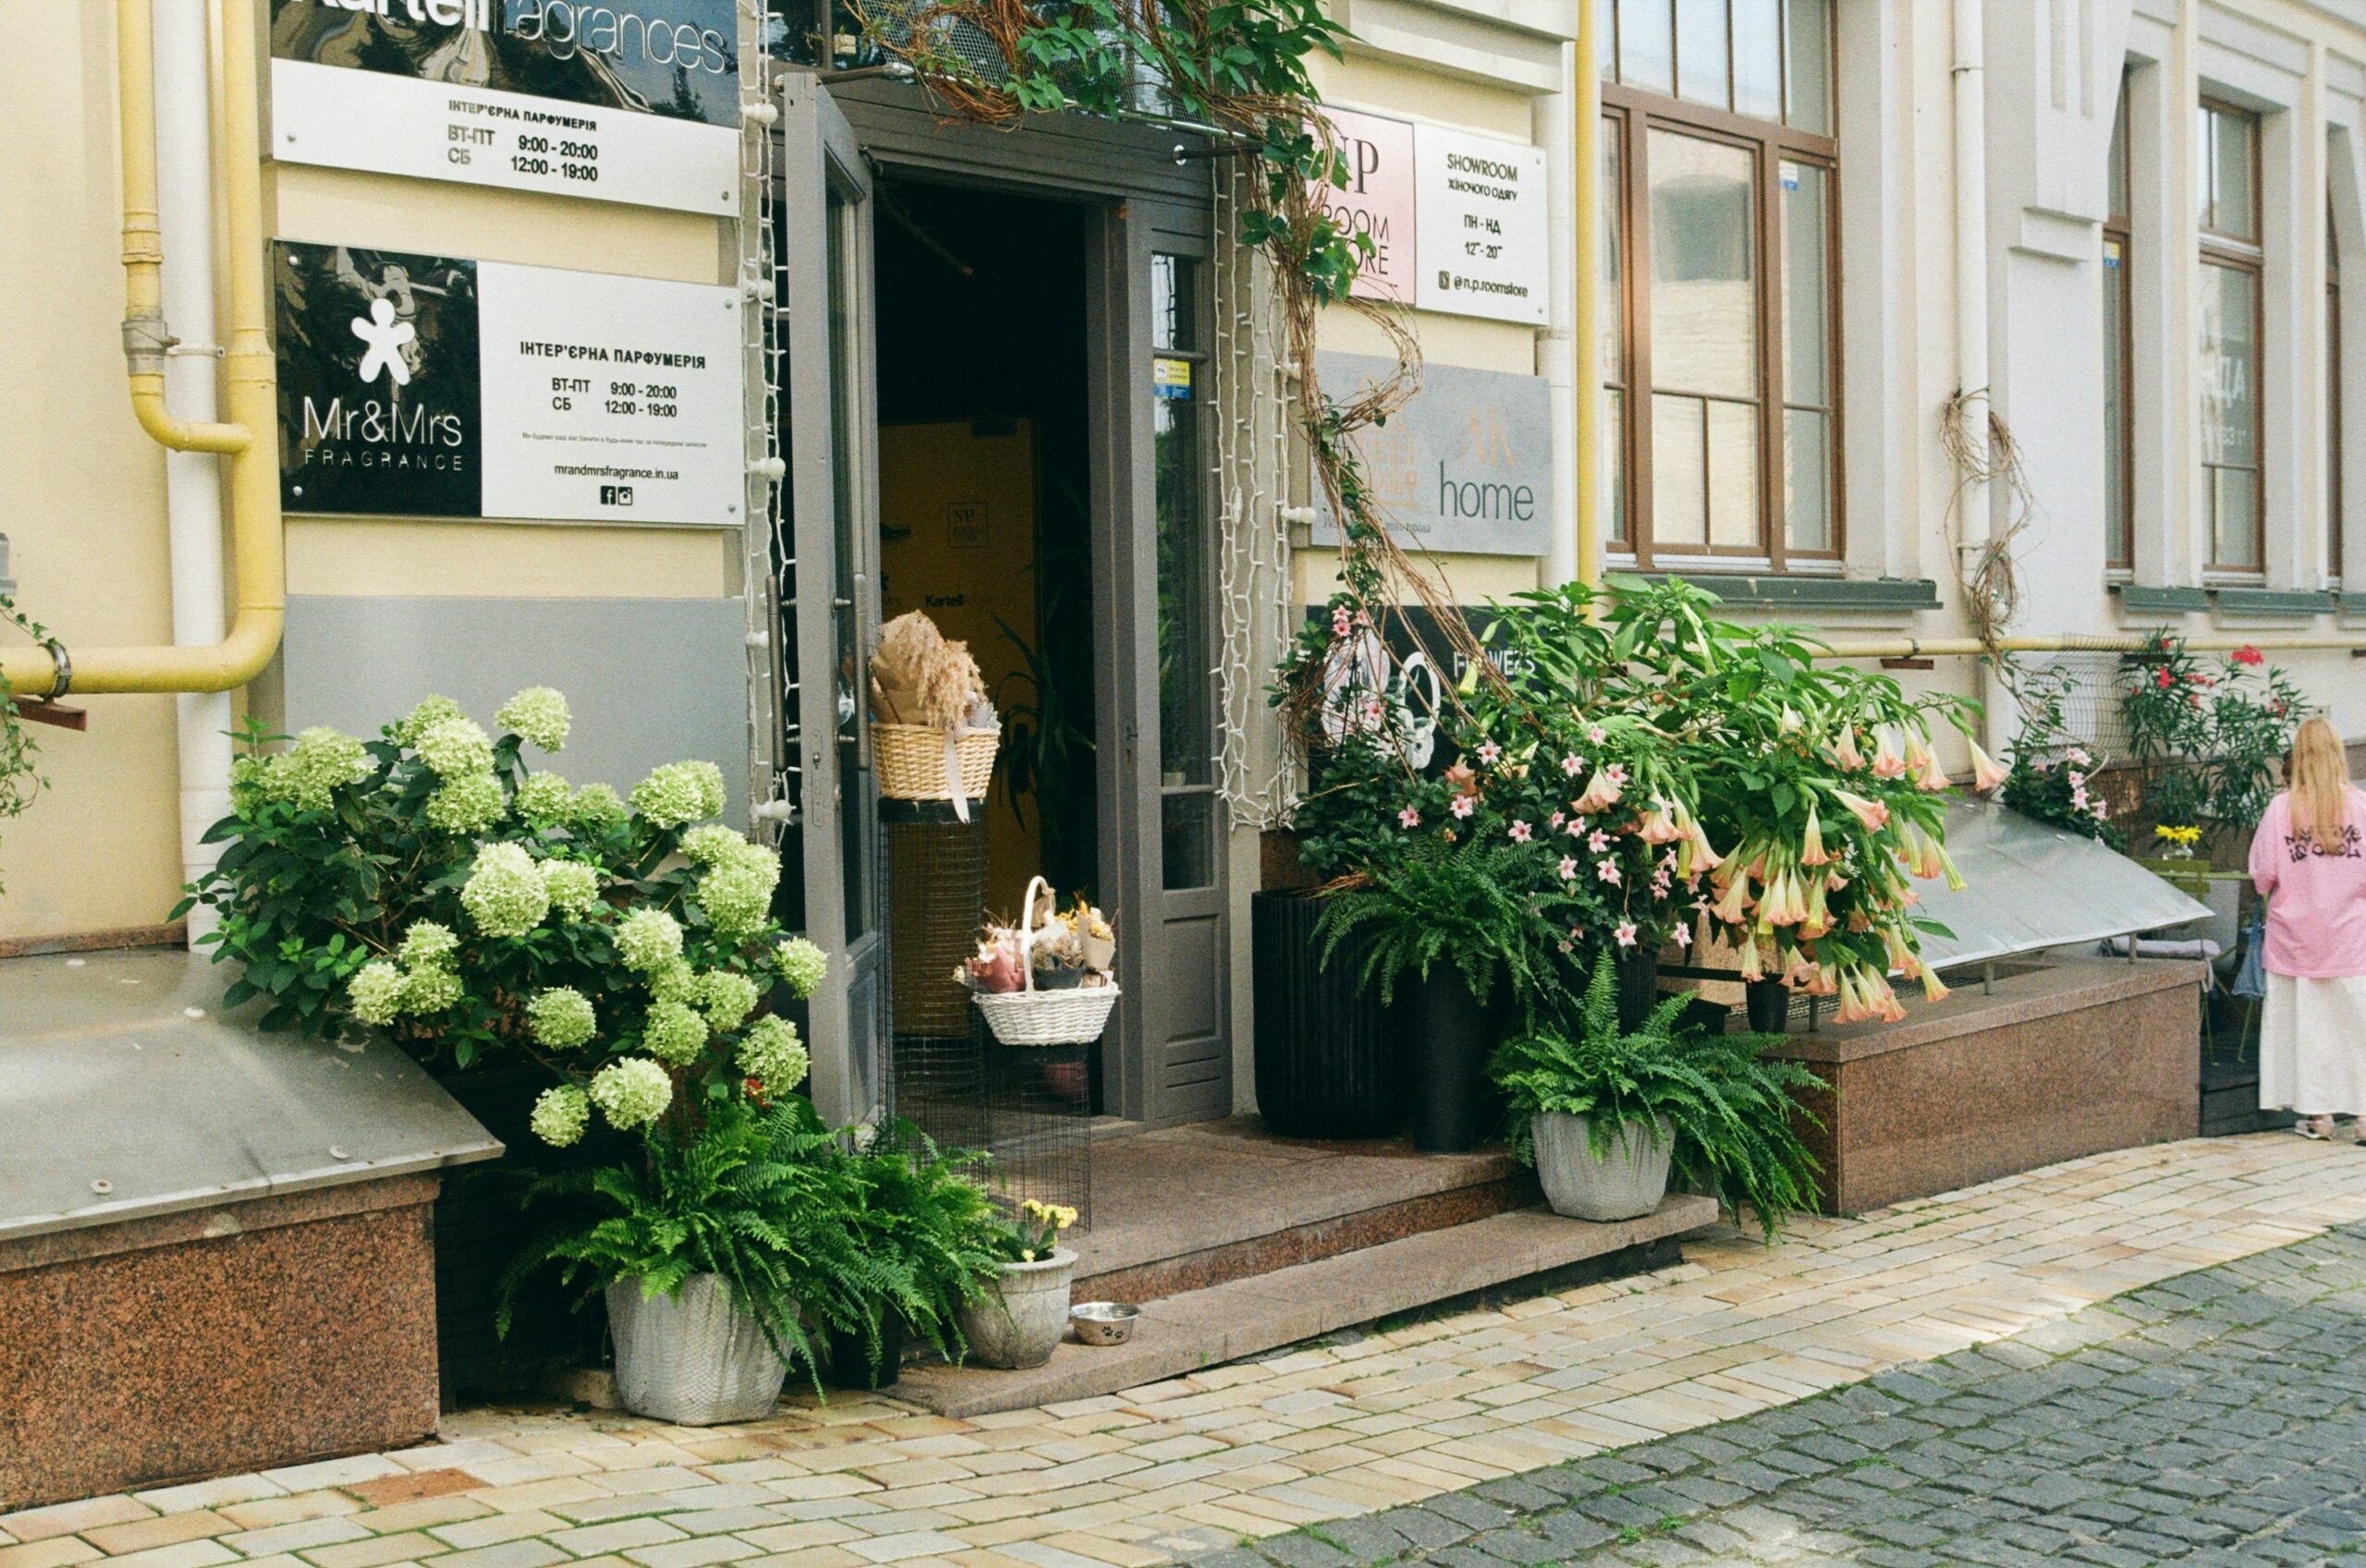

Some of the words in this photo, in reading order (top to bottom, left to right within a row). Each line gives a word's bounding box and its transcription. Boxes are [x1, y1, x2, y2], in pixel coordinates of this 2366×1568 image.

[448, 100, 519, 120] ІНТЕР'ЄРНА
[523, 111, 597, 131] ПАРФУМЕРІЯ
[447, 124, 495, 146] ВТ-ПТ
[518, 135, 549, 153] 9:00
[560, 140, 598, 160] 20:00
[447, 147, 471, 164] СБ
[511, 155, 549, 175] 12:00
[561, 163, 598, 181] 19:00
[1447, 152, 1518, 182] SHOWROOM
[1464, 213, 1478, 229] ПН
[1486, 217, 1501, 236] НД
[520, 340, 609, 361] ІНТЕР'ЄРНА
[614, 348, 706, 370] ПАРФУМЕРІЯ
[552, 377, 591, 393] ВТ-ПТ
[610, 382, 636, 396] 9:00
[645, 384, 677, 399] 20:00
[304, 395, 462, 447] Mr&Mrs
[552, 396, 572, 411] СБ
[604, 400, 636, 415] 12:00
[647, 403, 677, 418] 19:00
[305, 449, 462, 471] FRAGRANCE
[555, 464, 679, 480] mrandmrsfragrance.in.ua
[1438, 459, 1534, 521] home
